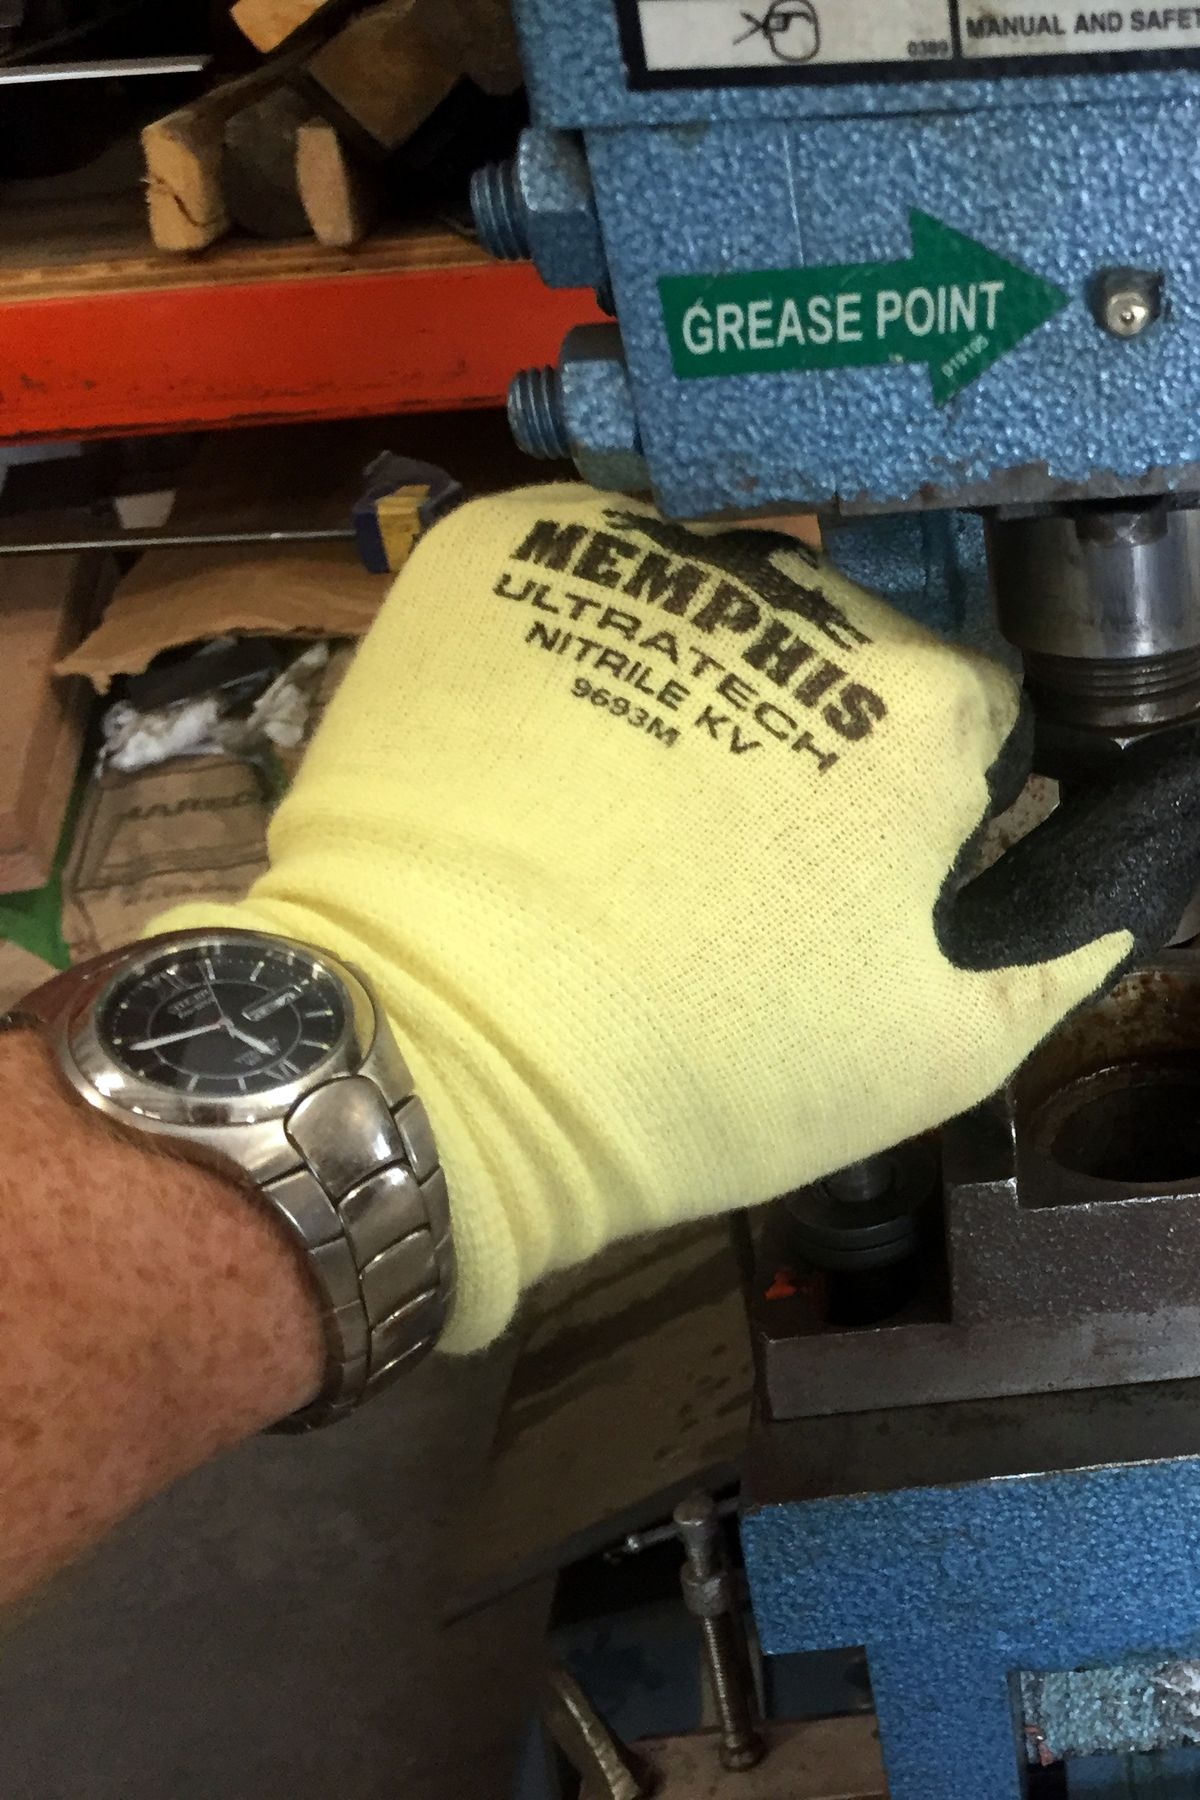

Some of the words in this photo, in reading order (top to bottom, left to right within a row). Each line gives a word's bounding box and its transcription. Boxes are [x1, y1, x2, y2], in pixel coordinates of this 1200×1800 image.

[966, 14, 1066, 39] MANUAL
[1073, 12, 1123, 35] AND
[682, 292, 863, 355] GREASE
[876, 280, 1004, 339] POINT
[492, 573, 839, 776] ULTRATECH
[509, 518, 889, 742] MEMPHIS
[524, 620, 691, 711] NITRILE
[694, 704, 764, 755] KV
[569, 677, 681, 748] 9693M
